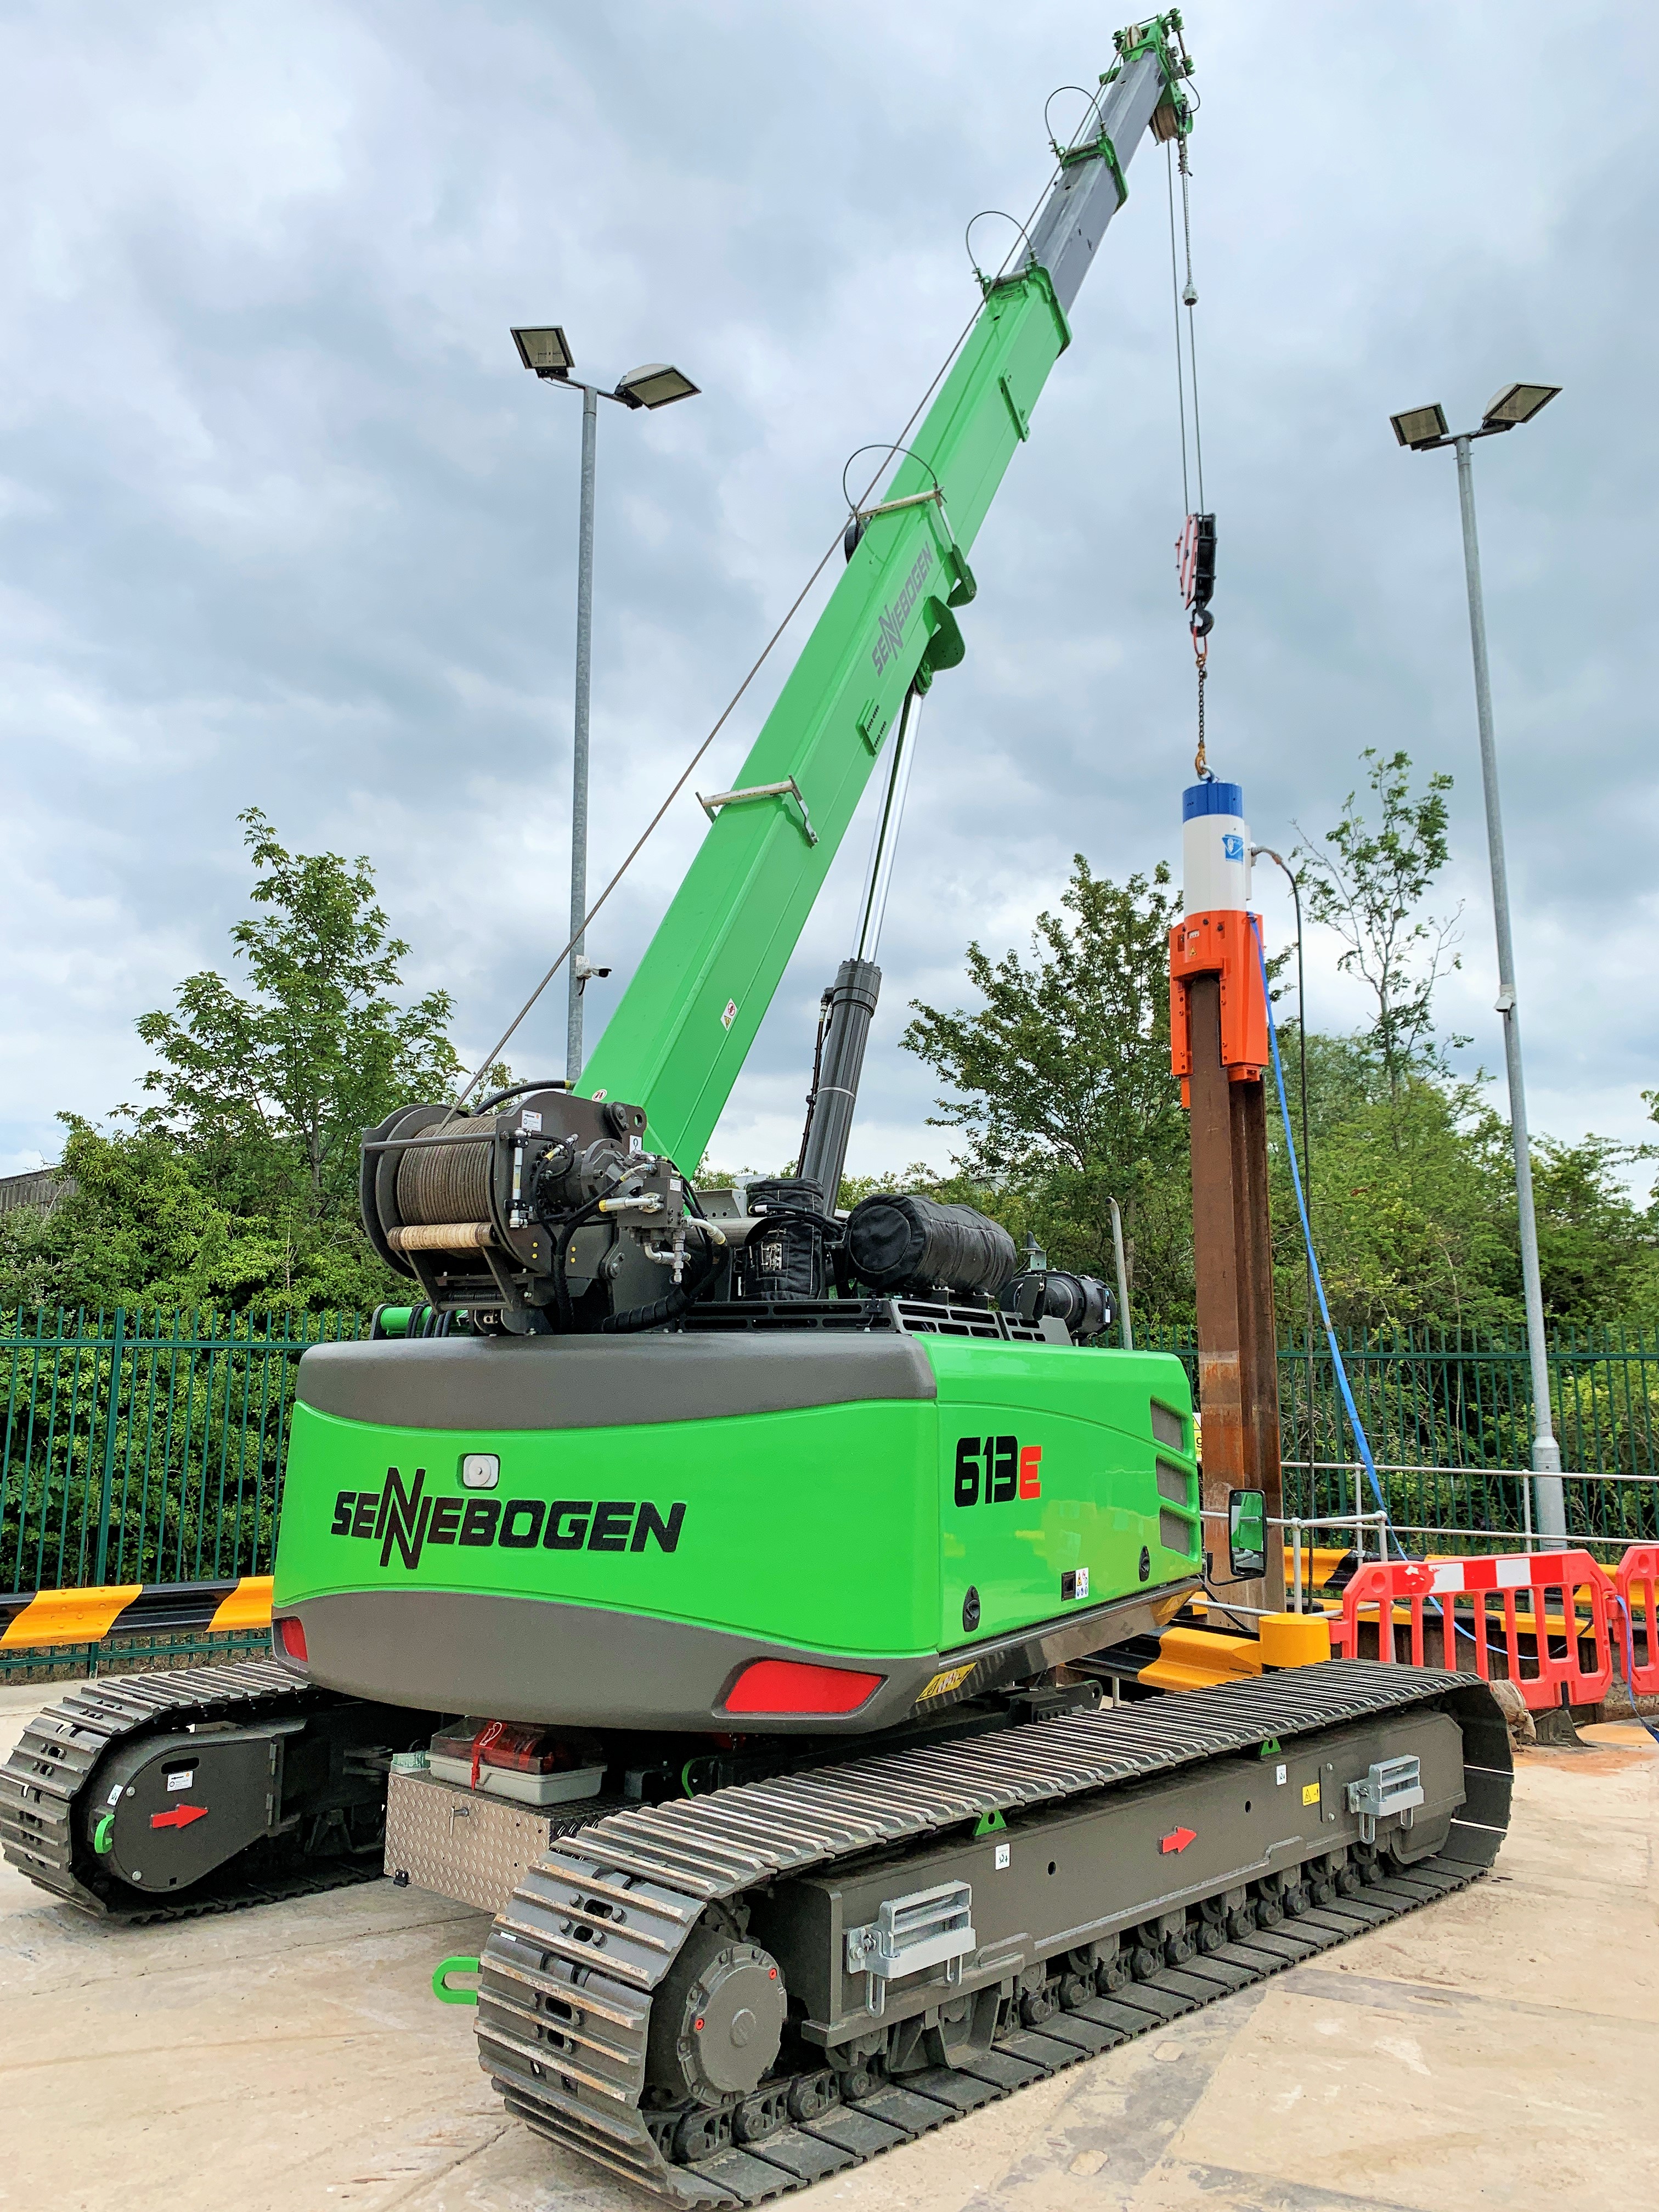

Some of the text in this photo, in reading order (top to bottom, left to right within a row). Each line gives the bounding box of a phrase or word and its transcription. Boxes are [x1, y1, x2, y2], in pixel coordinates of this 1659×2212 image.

[872, 540, 933, 678] SENNEBOGEN
[330, 1467, 687, 1570] SENNEBOGEN
[954, 1435, 1042, 1508] 613E
